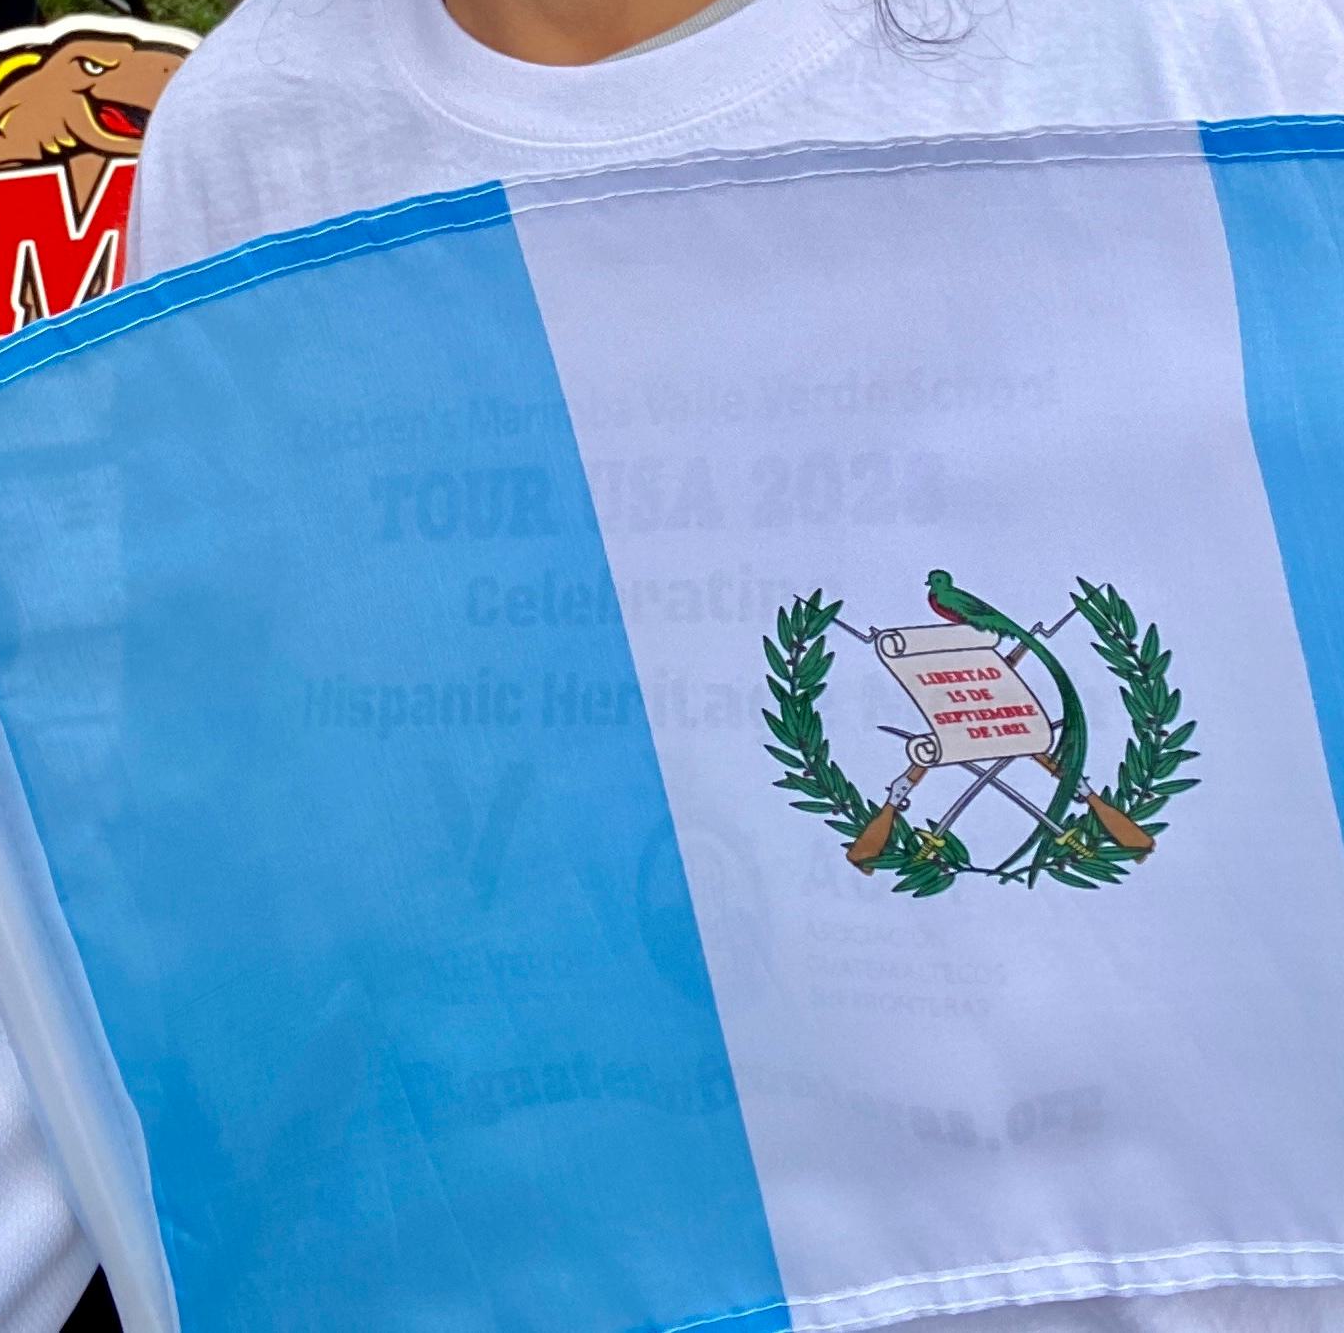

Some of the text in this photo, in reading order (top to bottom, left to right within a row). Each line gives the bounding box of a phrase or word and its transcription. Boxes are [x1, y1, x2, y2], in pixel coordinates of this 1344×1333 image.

[368, 465, 561, 542] TOUR
[916, 667, 1002, 686] LIBERTAD
[304, 667, 524, 740] Hispanic
[945, 688, 994, 703] 15 DE
[933, 704, 1039, 725] SEPTIEMBRE
[967, 722, 1031, 740] DE 1821
